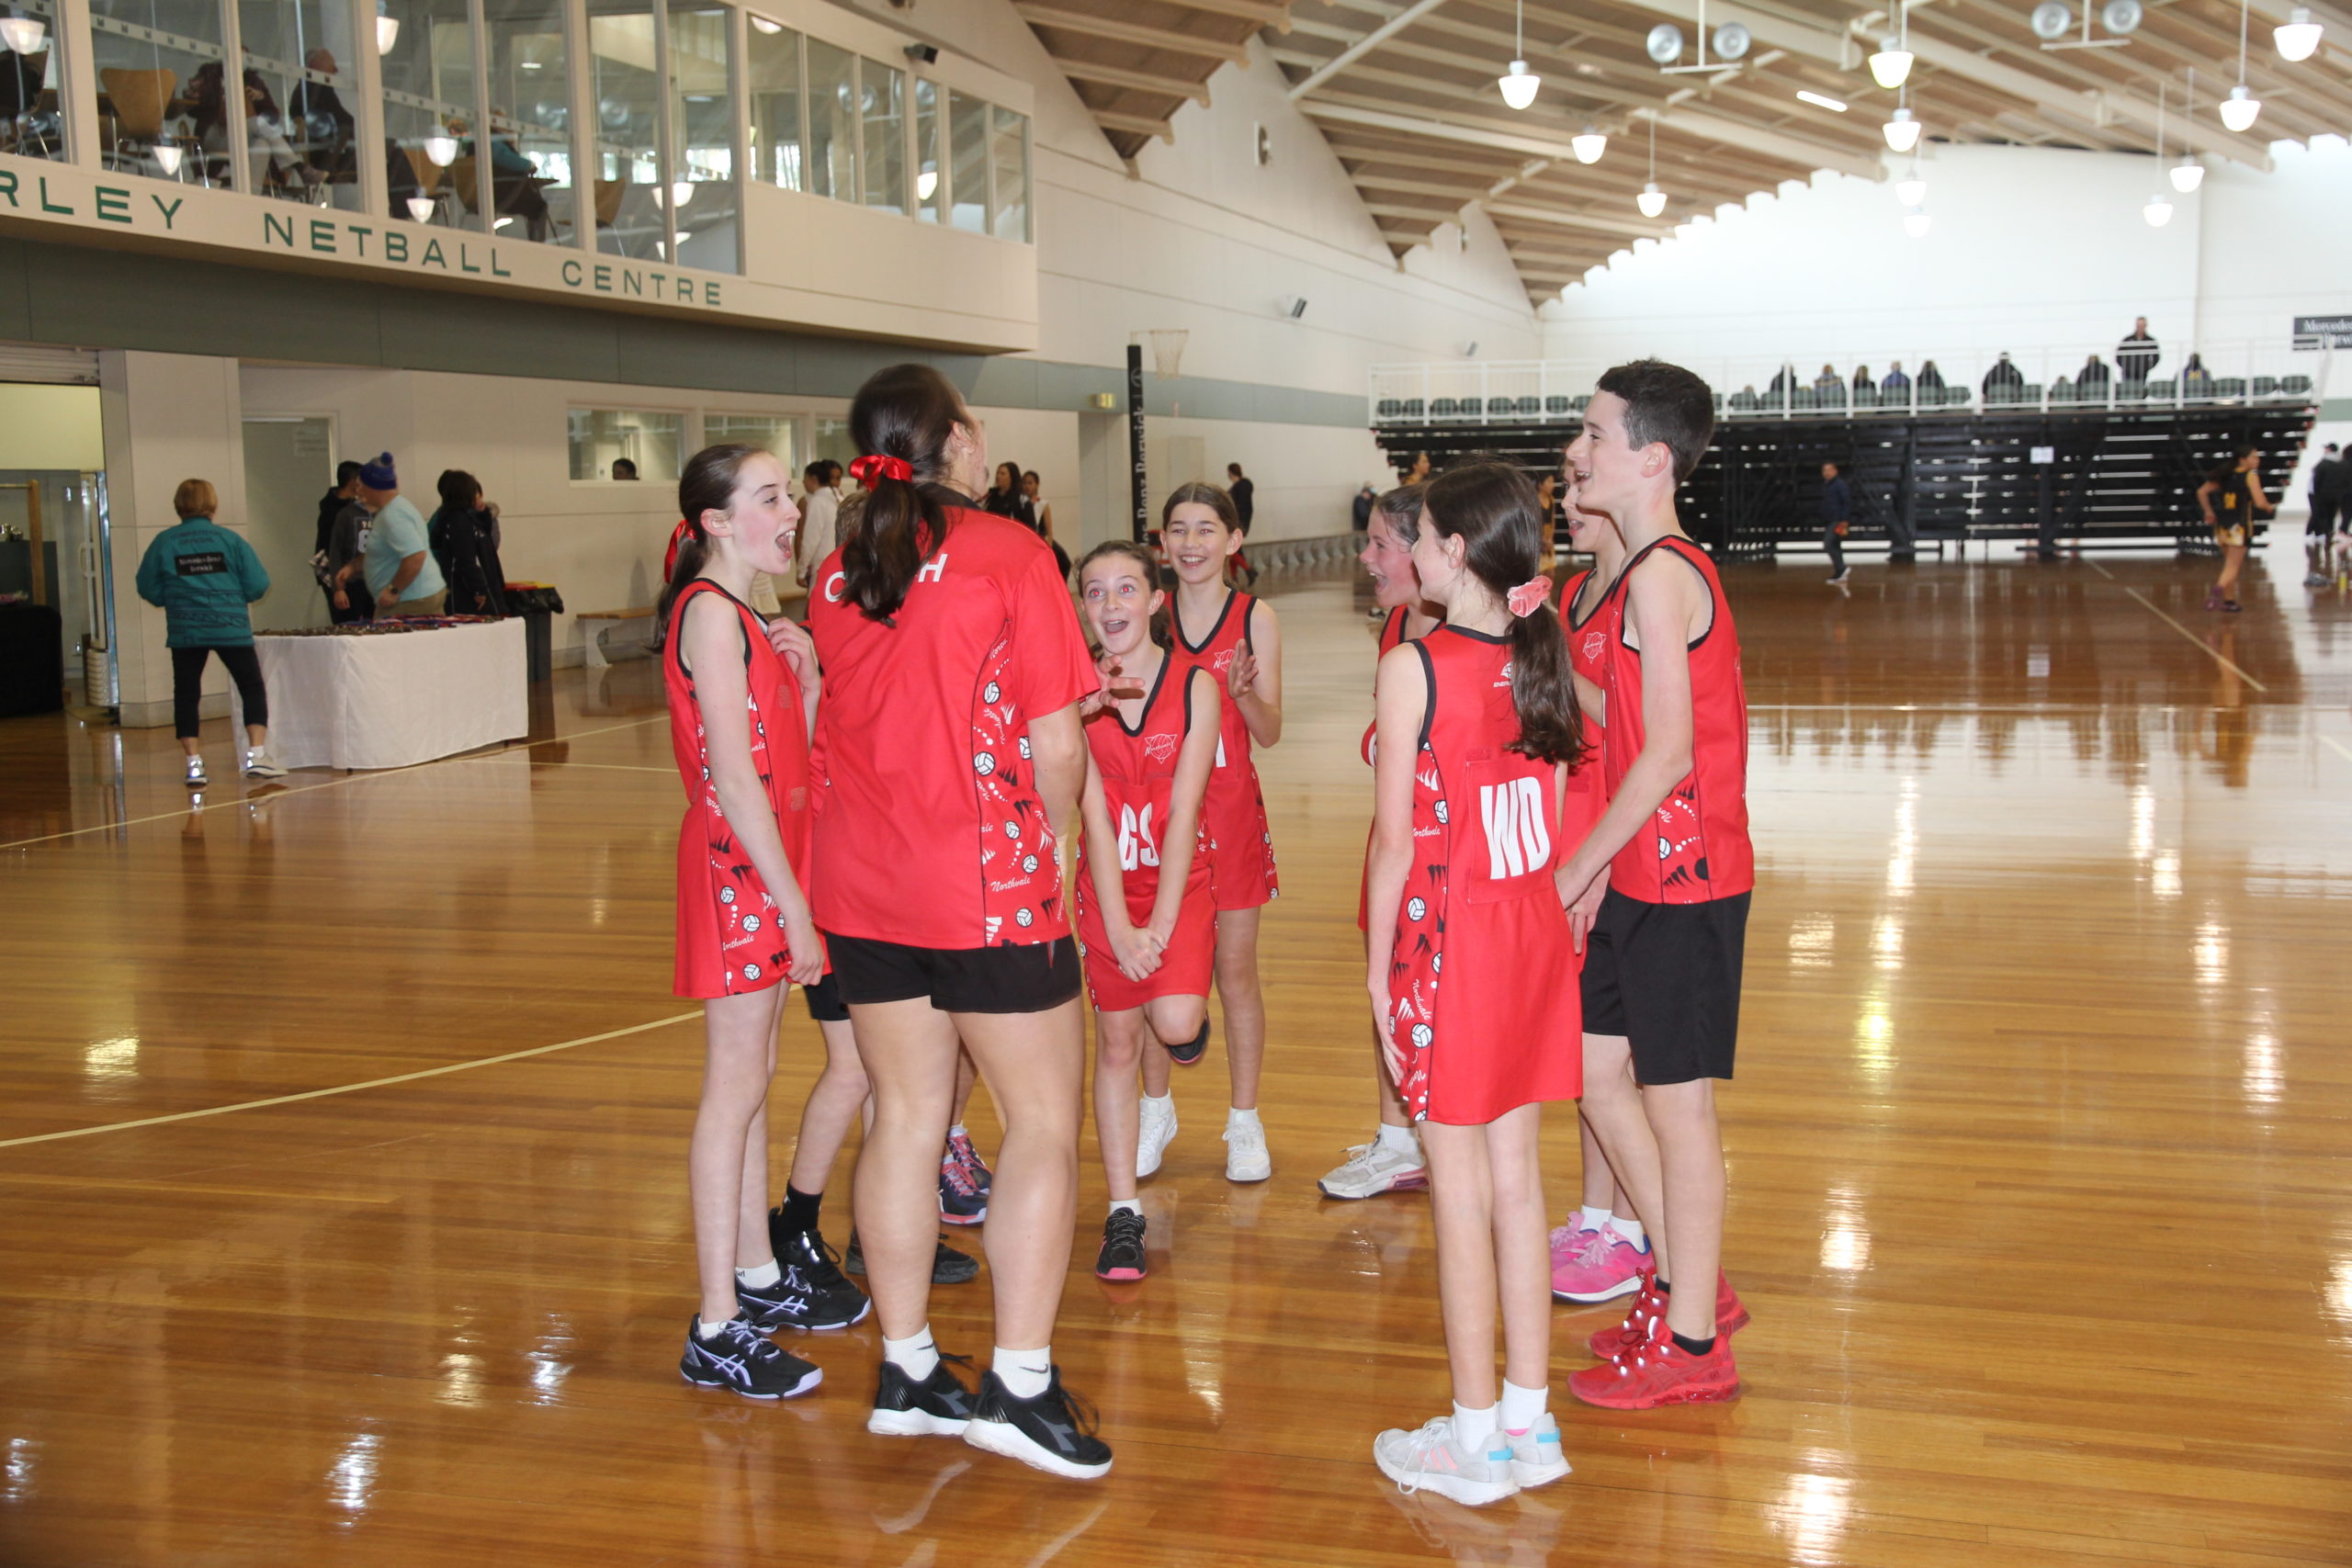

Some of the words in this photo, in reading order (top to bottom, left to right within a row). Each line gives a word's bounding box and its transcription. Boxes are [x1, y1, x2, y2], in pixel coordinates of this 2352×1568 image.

[0, 170, 183, 230] RLEY
[265, 212, 511, 277] NETBALL
[562, 260, 720, 306] CENTRE
[1118, 802, 1159, 871] GS
[1480, 776, 1550, 879] WD
[990, 875, 1031, 893] Northvale
